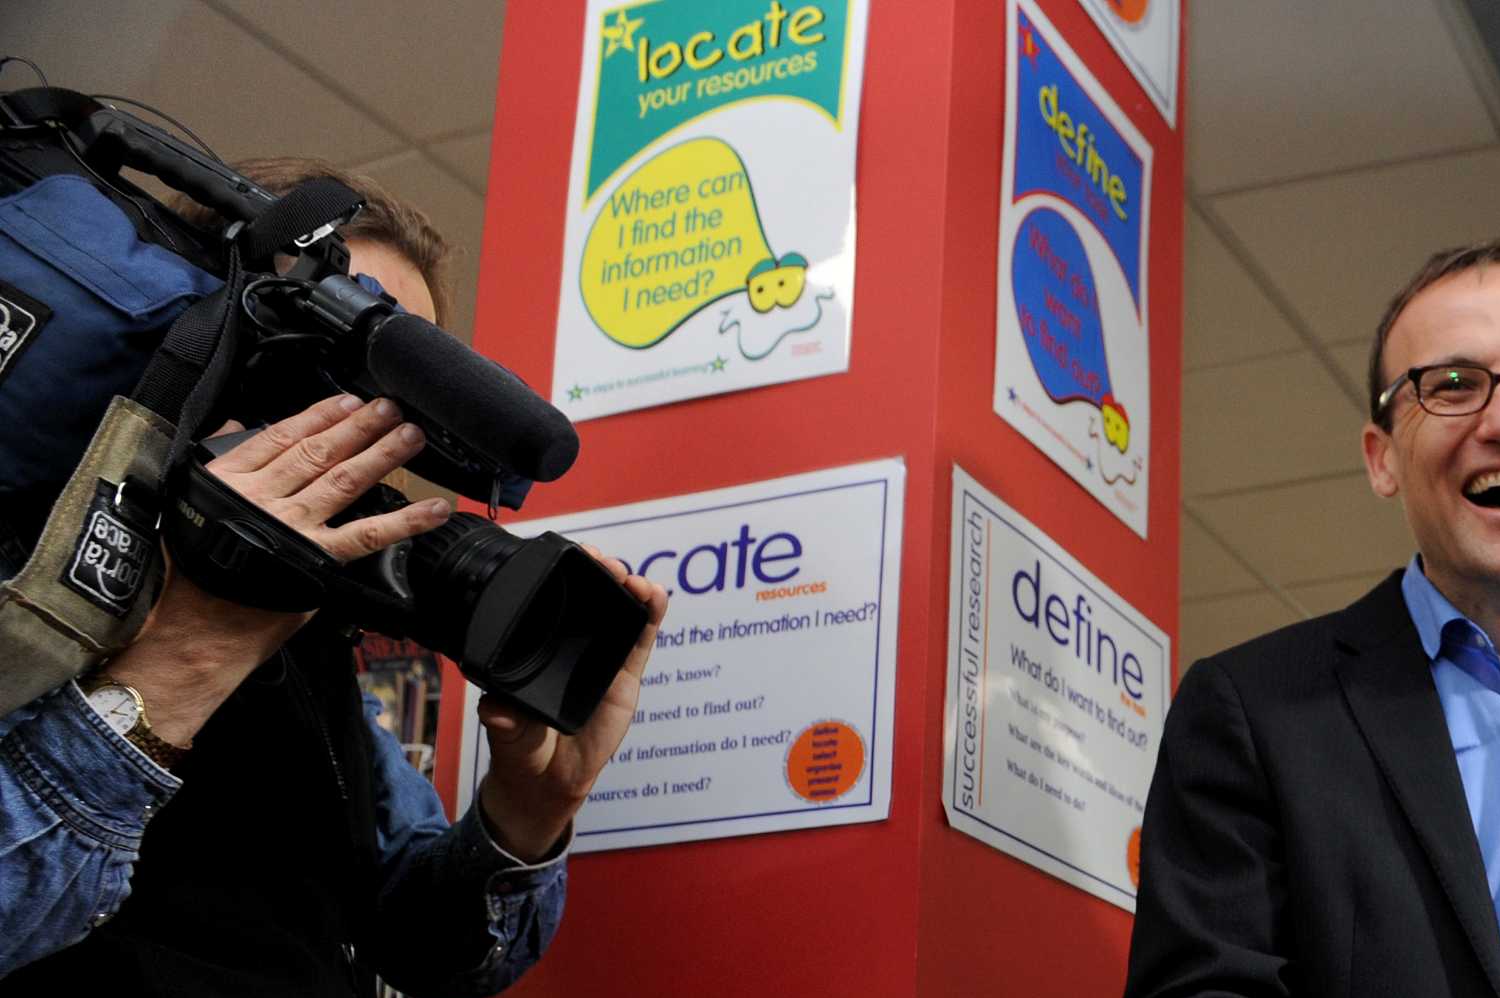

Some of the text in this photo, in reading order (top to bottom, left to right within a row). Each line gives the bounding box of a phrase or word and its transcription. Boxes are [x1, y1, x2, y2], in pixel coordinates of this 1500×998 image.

[638, 1, 826, 82] locate
[638, 49, 818, 118] your resources
[1040, 85, 1128, 220] define
[609, 170, 744, 220] Where can
[618, 207, 723, 250] I find the
[601, 235, 743, 285] information
[623, 270, 715, 312] I need?
[84, 541, 139, 588] porta
[607, 525, 802, 598] cate
[756, 580, 828, 603] resources
[656, 603, 877, 649] find the information I need?
[1011, 559, 1144, 700] define
[676, 664, 722, 683] know?
[961, 510, 984, 809] successful research
[649, 705, 682, 723] need
[686, 706, 700, 719] to
[703, 698, 733, 717] find
[735, 697, 765, 713] out?
[1010, 643, 1042, 681] What
[1044, 667, 1059, 692] do
[1067, 685, 1093, 715] want
[1095, 700, 1105, 723] to
[1107, 708, 1125, 738] find
[1128, 727, 1148, 751] out?
[618, 749, 634, 763] of
[636, 740, 717, 761] information
[720, 737, 738, 751] do
[752, 730, 792, 747] need?
[1007, 759, 1027, 780] What
[641, 782, 660, 797] do
[662, 782, 669, 795] I
[672, 778, 712, 794] need?
